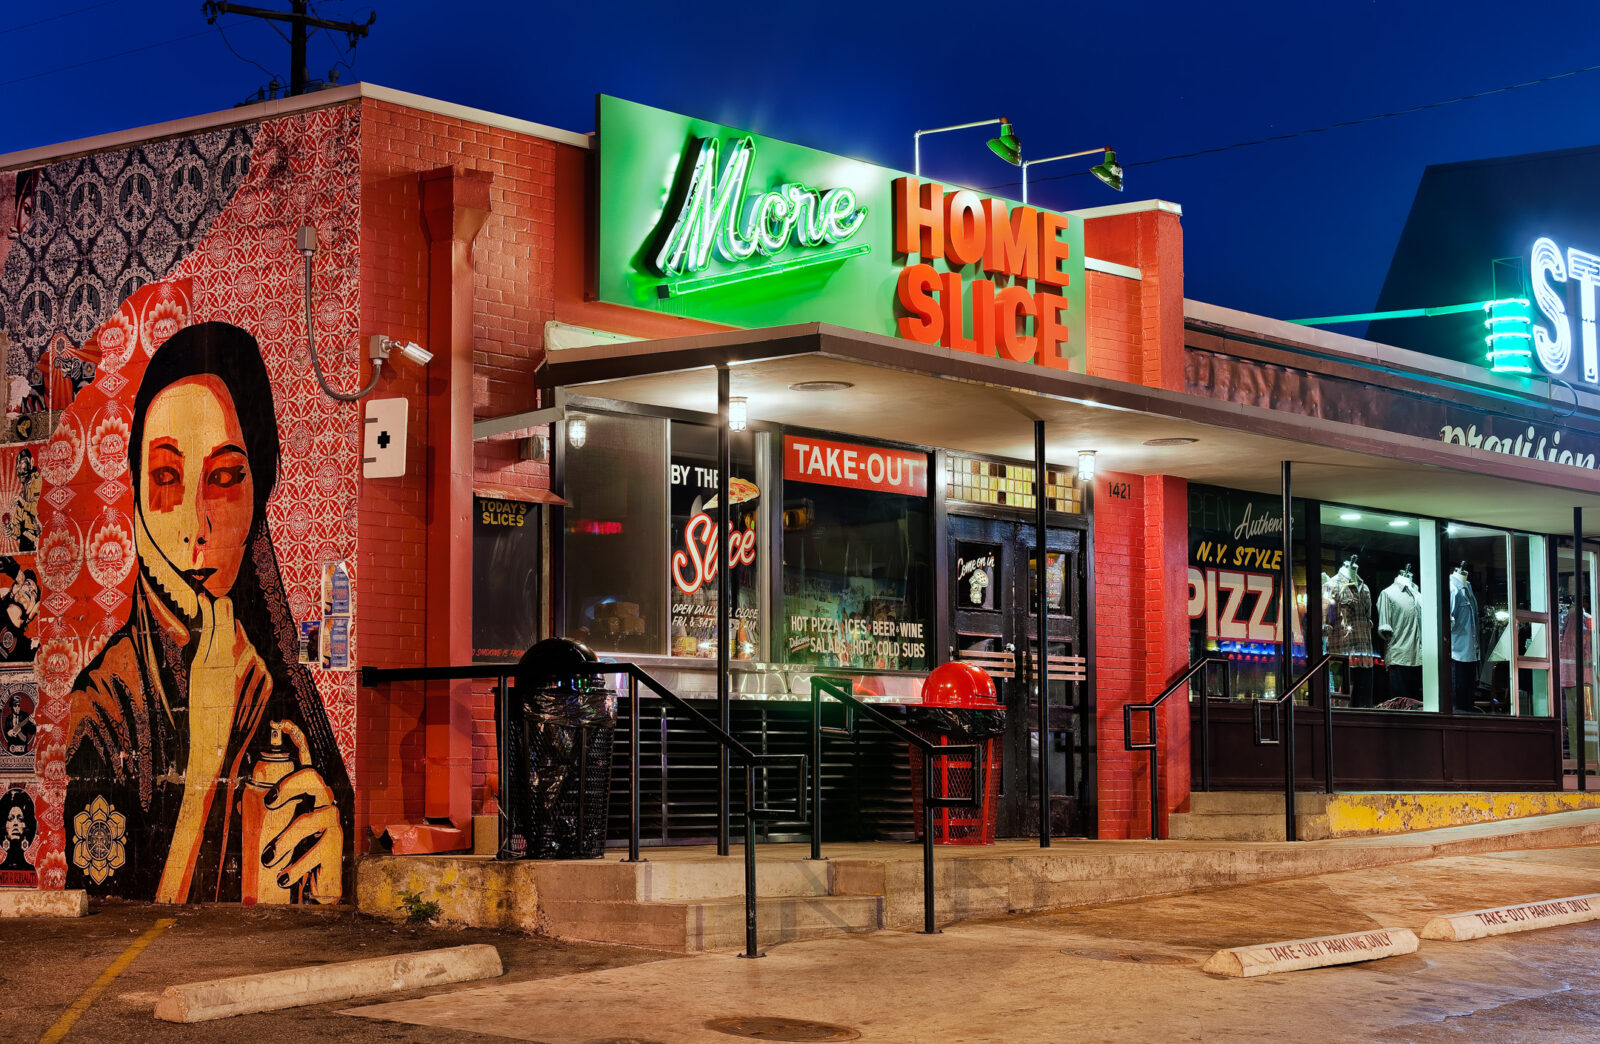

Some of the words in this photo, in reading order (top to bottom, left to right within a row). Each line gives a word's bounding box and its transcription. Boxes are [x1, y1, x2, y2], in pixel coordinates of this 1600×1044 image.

[656, 135, 869, 278] More
[891, 176, 1070, 287] HOME
[896, 263, 1070, 372] SLICE
[1440, 424, 1600, 470] provision
[671, 464, 690, 486] BY
[695, 467, 718, 489] THE
[793, 443, 919, 487] TAKE-OUT
[101, 483, 121, 498] OBEY
[1108, 481, 1131, 500] 1421
[480, 500, 527, 515] TODAY'S
[482, 511, 525, 527] SLICES
[1234, 502, 1294, 540] Authenc
[672, 513, 756, 595] Slce
[957, 558, 976, 581] Come
[976, 556, 987, 568] on
[986, 552, 995, 568] in
[1196, 541, 1226, 564] N.Y.
[1233, 546, 1284, 570] STYLE
[672, 603, 694, 614] OPEN
[694, 605, 718, 616] DAILY
[735, 608, 759, 619] CLOSE
[791, 615, 808, 632] HOT
[811, 617, 839, 633] PIZZA
[845, 619, 867, 634] ICES
[872, 620, 896, 637] BEER
[900, 622, 924, 639] WINE
[810, 637, 847, 654] SALADS
[852, 641, 871, 655] HOT
[877, 641, 900, 657] COLD
[902, 642, 925, 658] SUBS
[1475, 907, 1530, 926] TAKE-OUT
[1527, 901, 1569, 919] PARKING
[1566, 898, 1592, 913] ONLY
[1266, 941, 1324, 961] TAKE-OUT
[1322, 935, 1367, 954] PARKING
[1364, 932, 1393, 948] ONLY
